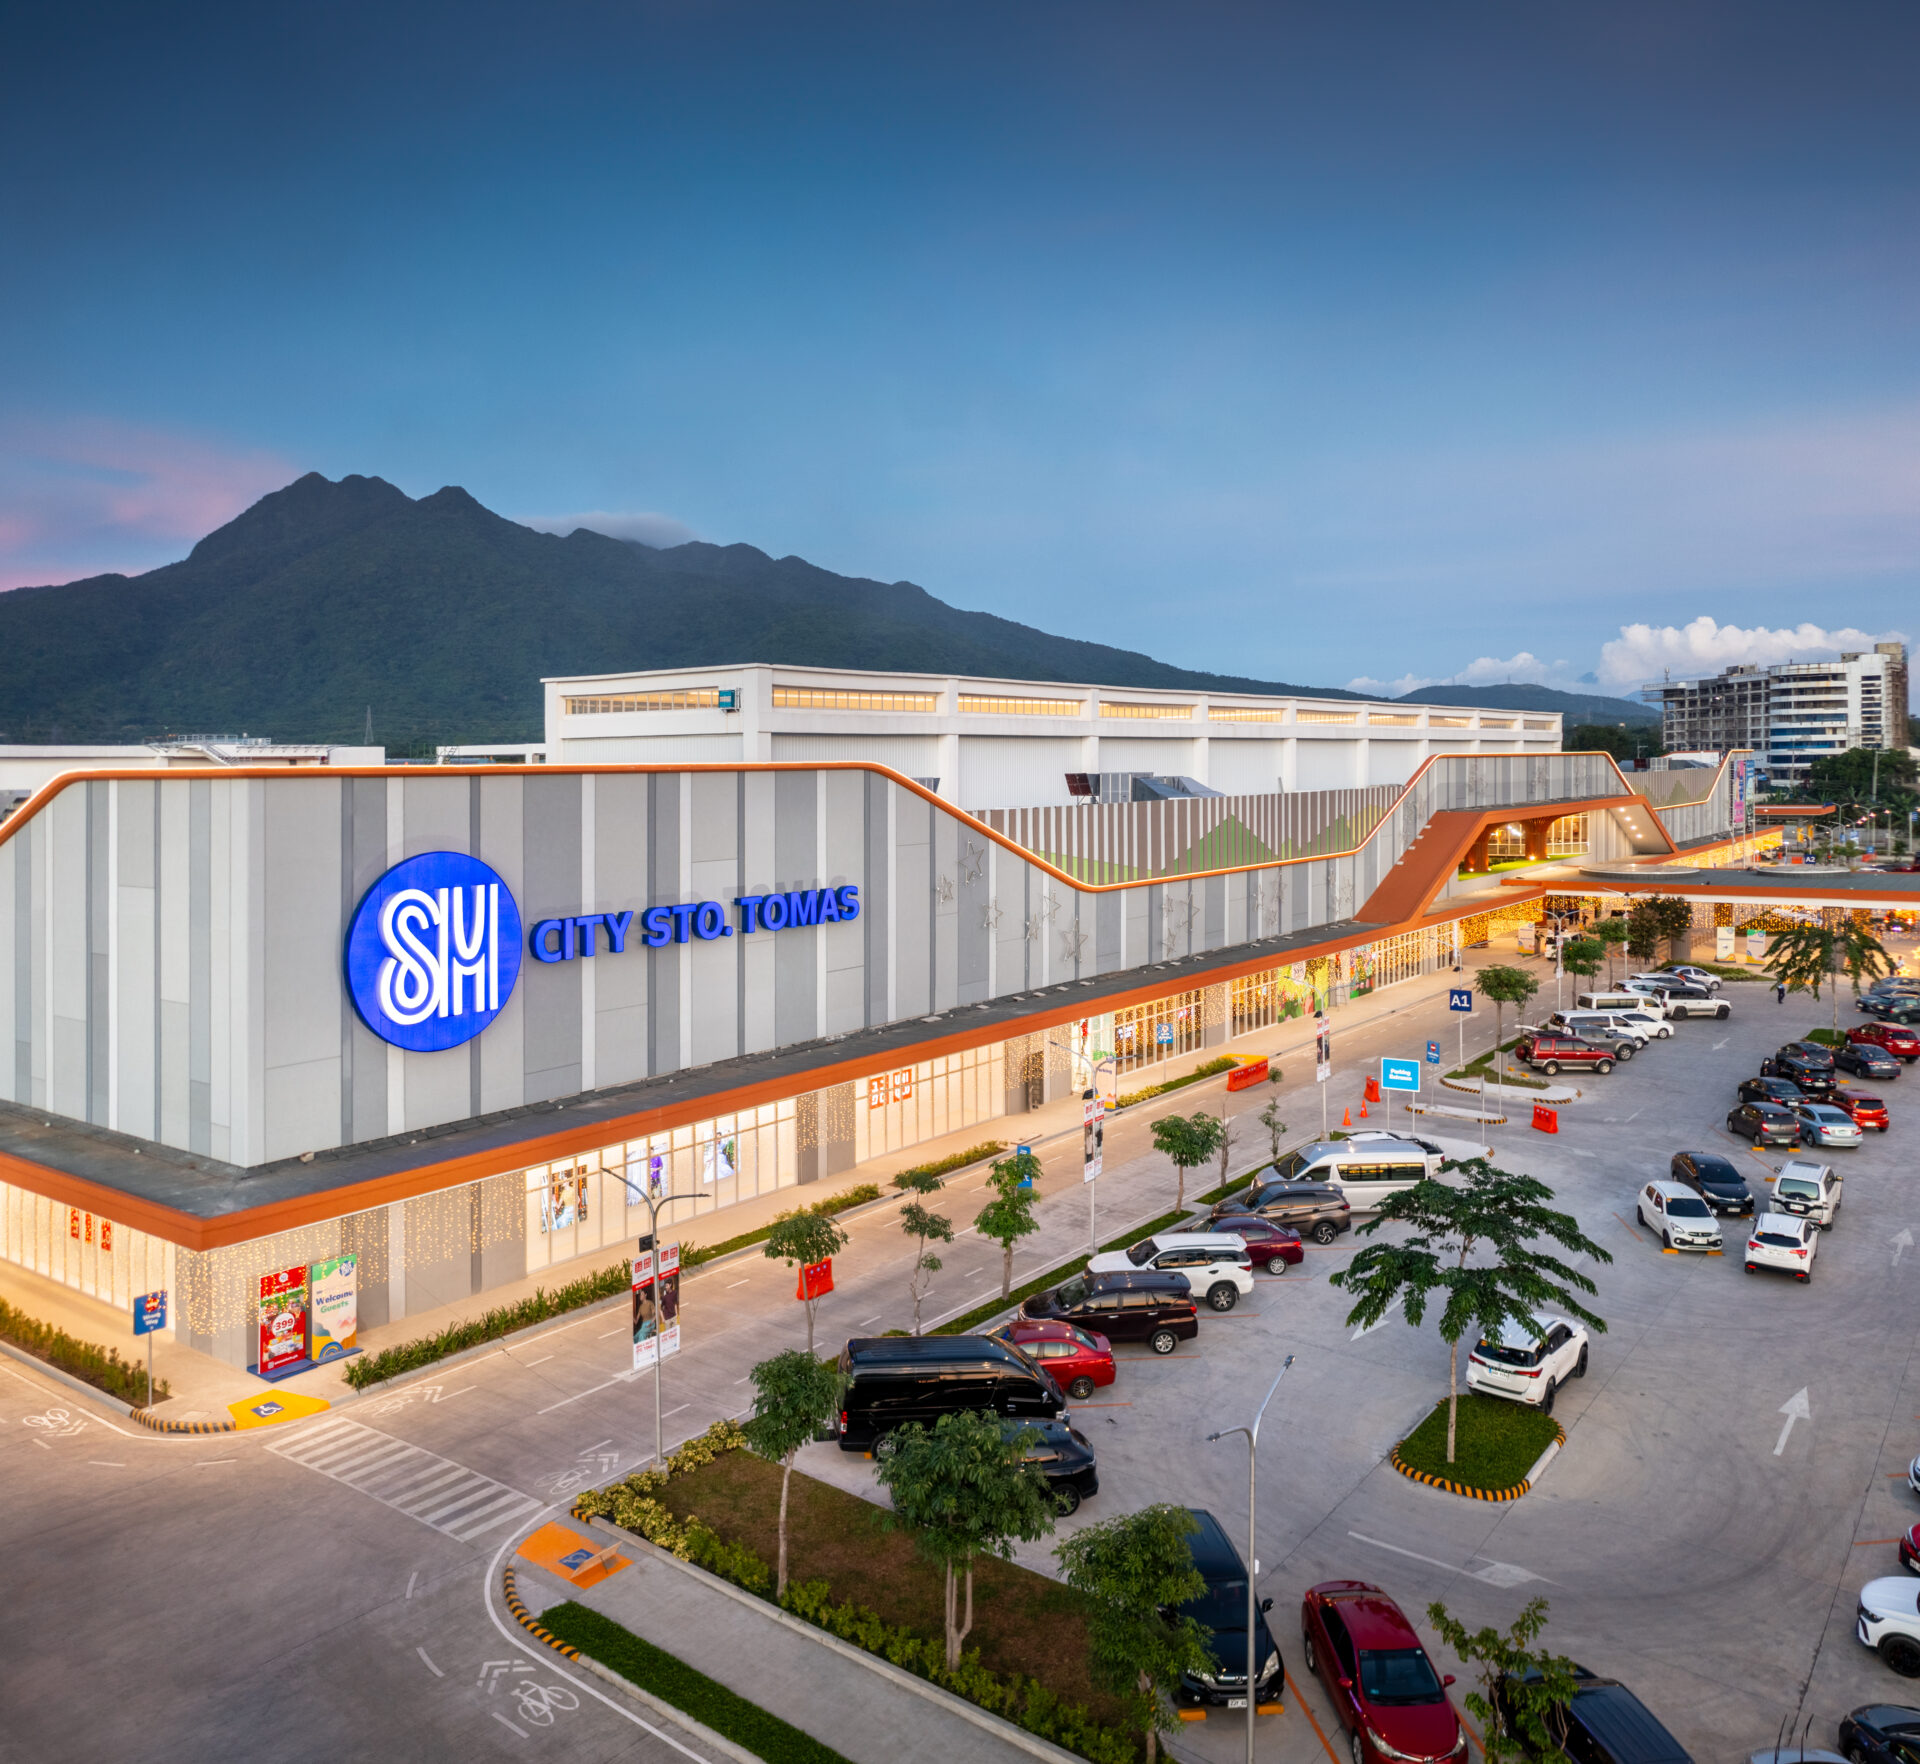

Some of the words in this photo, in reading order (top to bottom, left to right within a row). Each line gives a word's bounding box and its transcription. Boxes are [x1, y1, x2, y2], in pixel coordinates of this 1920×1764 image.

[378, 883, 499, 1026] SM
[530, 910, 634, 964] CITY
[642, 900, 733, 948] STO.
[734, 885, 860, 934] TOMAS
[1451, 994, 1470, 1007] A1
[1390, 1067, 1412, 1077] Parking
[320, 1300, 349, 1313] Guests
[274, 1317, 294, 1331] 399
